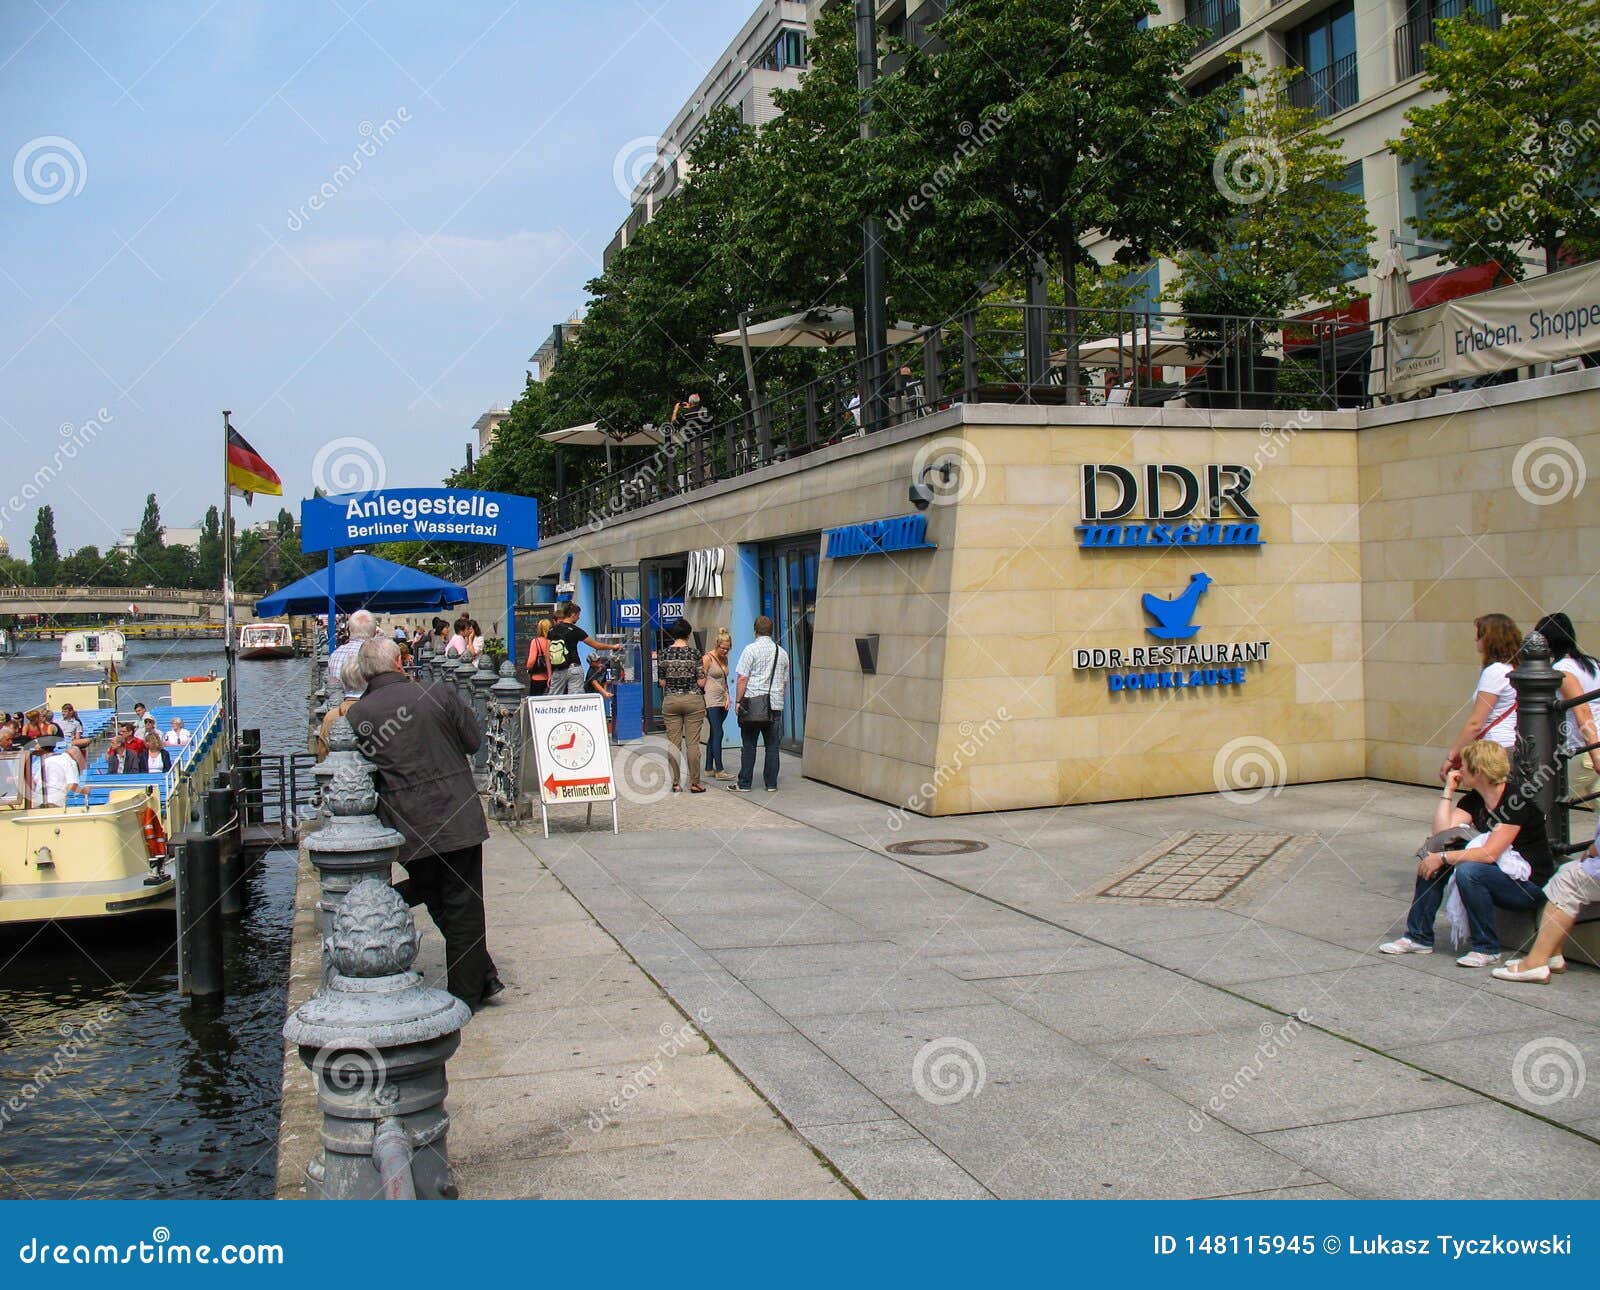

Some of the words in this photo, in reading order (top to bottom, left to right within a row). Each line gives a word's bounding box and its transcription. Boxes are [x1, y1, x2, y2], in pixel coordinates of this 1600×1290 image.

[1456, 323, 1522, 355] Erleben.
[1529, 303, 1600, 339] Shoppe
[1079, 463, 1260, 521] DDR
[345, 495, 500, 520] Anlegestelle
[347, 521, 409, 538] Berliner
[413, 520, 497, 537] Wassertaxi
[1074, 523, 1267, 548] museum
[1073, 641, 1271, 669] DDR-RESTAURANT
[1109, 667, 1247, 691] DOMKLAUSE
[568, 704, 598, 713] Abfahrt
[562, 785, 589, 798] Berliner
[590, 783, 610, 796] Kindl
